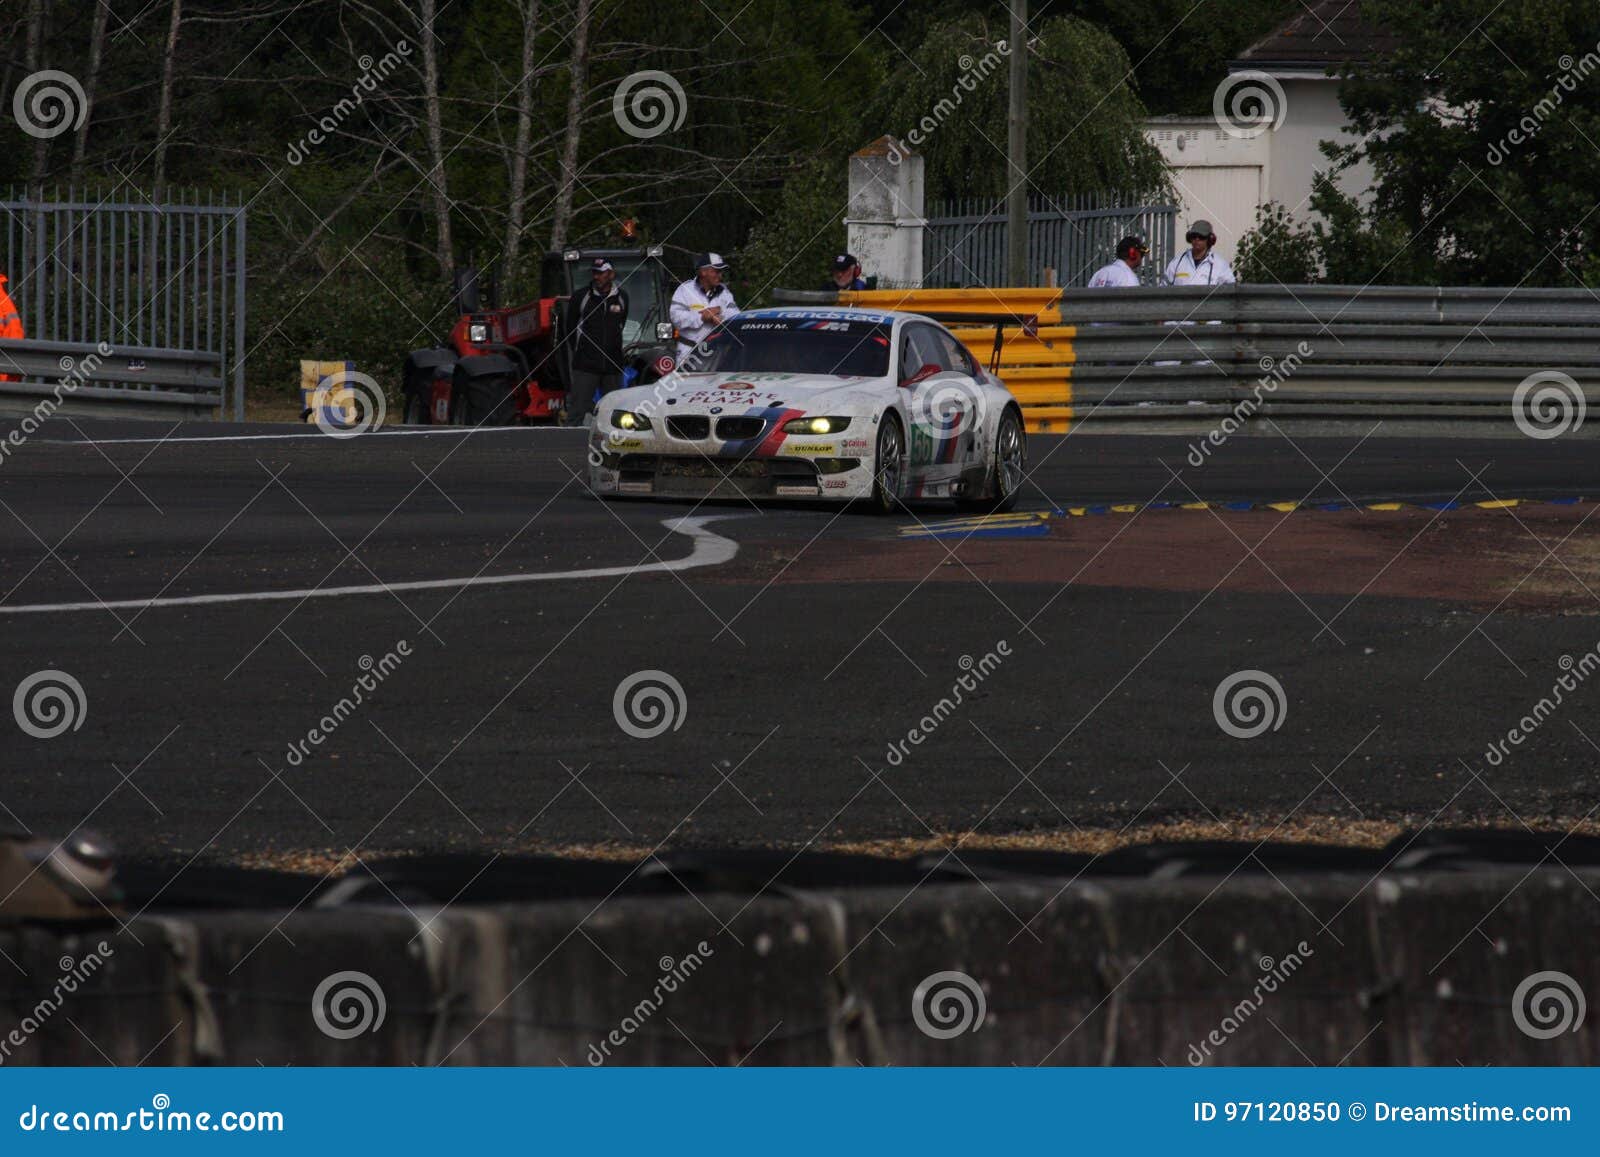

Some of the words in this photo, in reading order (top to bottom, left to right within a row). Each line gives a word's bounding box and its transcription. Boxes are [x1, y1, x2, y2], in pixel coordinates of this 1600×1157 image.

[776, 311, 884, 323] randstad
[681, 391, 777, 400] CROWNE
[687, 397, 754, 405] PLAZA
